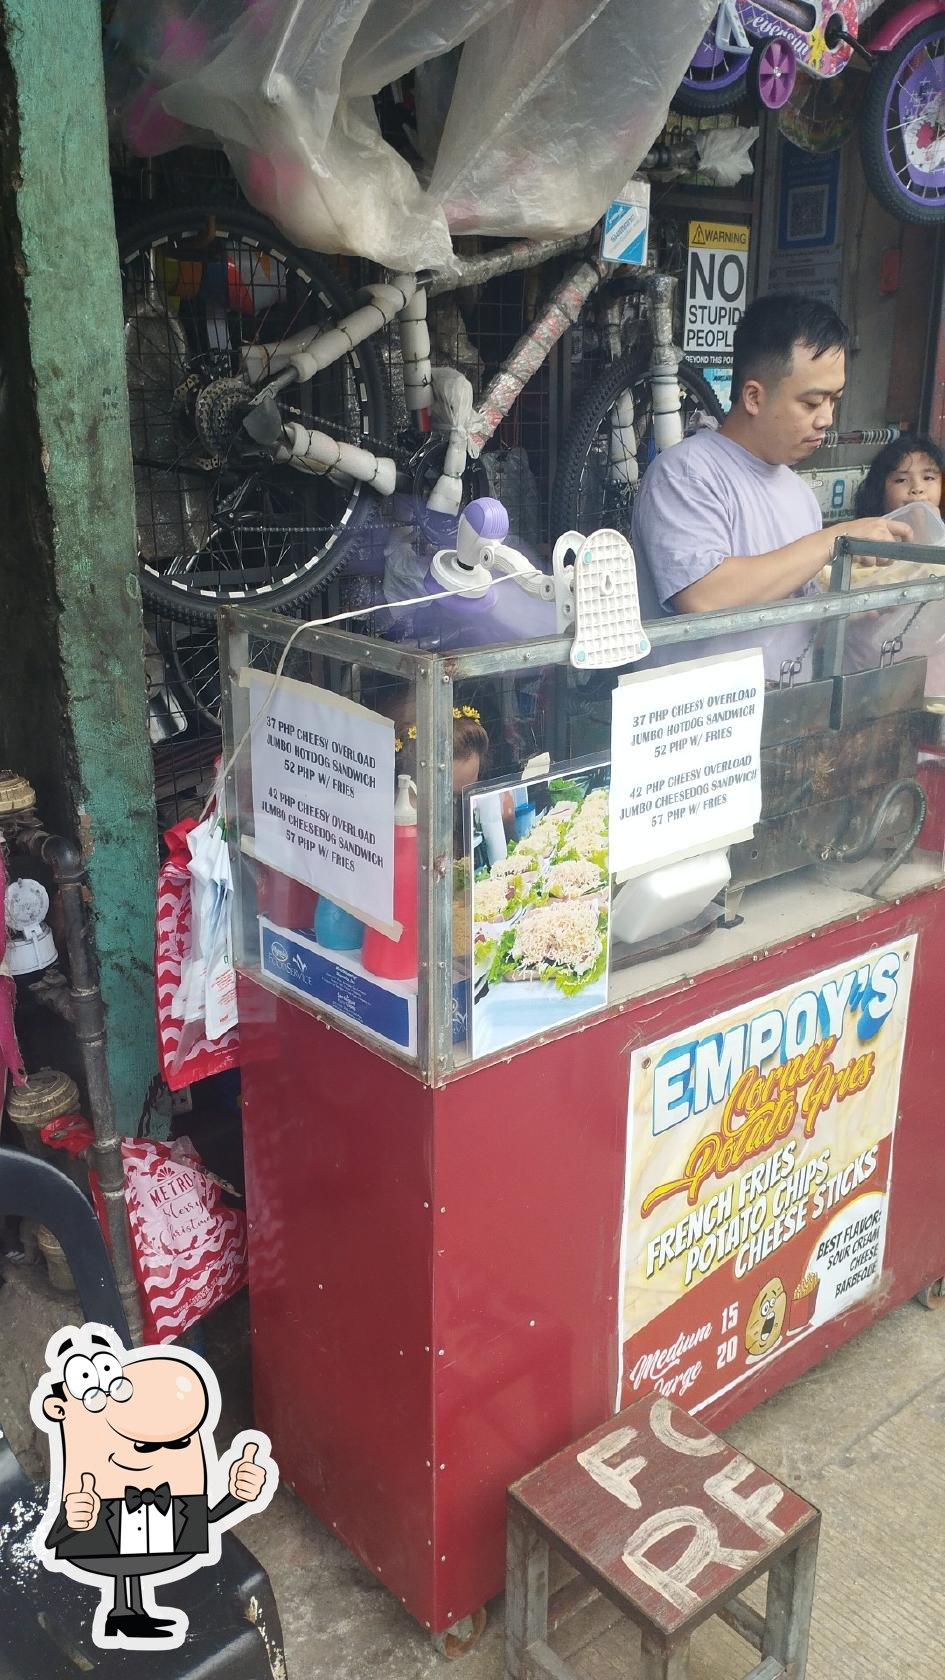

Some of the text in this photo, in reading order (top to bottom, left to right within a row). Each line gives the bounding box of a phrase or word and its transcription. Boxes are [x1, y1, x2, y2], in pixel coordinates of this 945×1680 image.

[705, 229, 746, 245] WARNING
[689, 252, 745, 303] NO
[689, 305, 741, 325] STUPID
[685, 355, 733, 364] BEYOND THIS POI
[687, 329, 732, 347] PEOPL
[631, 703, 755, 746] JUMBO HOTDOG SANDWICH
[632, 688, 756, 727] 37 PHP CHEESY OVERLOAD
[266, 716, 376, 769] 37 PHP CHEESY OVERLOAD
[266, 733, 376, 788] JUMBO HOTDOG SANDWICH
[654, 726, 732, 758] 52 PHP W/ FRIES
[284, 760, 355, 798] 52 PHP W/ FRIES
[619, 769, 757, 820] JUMBO CHEESEDOG SANDWICH
[629, 755, 752, 799] 42 PHP CHEESY OVERLOAD
[268, 786, 376, 845] 42 PHP CHEESY OVERLOAD
[651, 793, 727, 827] 57 PHP W/ FRIES
[262, 801, 383, 868] JUMBO CHEESEDOG SANDWICH
[286, 829, 355, 872] 57 PHP W/ FRIES
[652, 952, 900, 1137] EMPOY'S
[721, 1034, 838, 1138] Corner
[641, 1090, 799, 1219] Potato
[150, 1173, 194, 1207] METRO
[646, 1140, 797, 1279] FRENCH FRIES
[734, 1144, 879, 1279] CHEESE STICKS
[159, 1213, 215, 1245] Christma
[684, 1149, 831, 1285] POTATO CHIPS
[816, 1209, 882, 1260] BEST FLAVOR:
[827, 1226, 880, 1270] SOUR CREAM
[849, 1243, 879, 1271] CHEESE
[835, 1261, 879, 1298] BARBEQUE
[630, 1301, 739, 1390] Medium 15
[716, 1335, 738, 1369] 20
